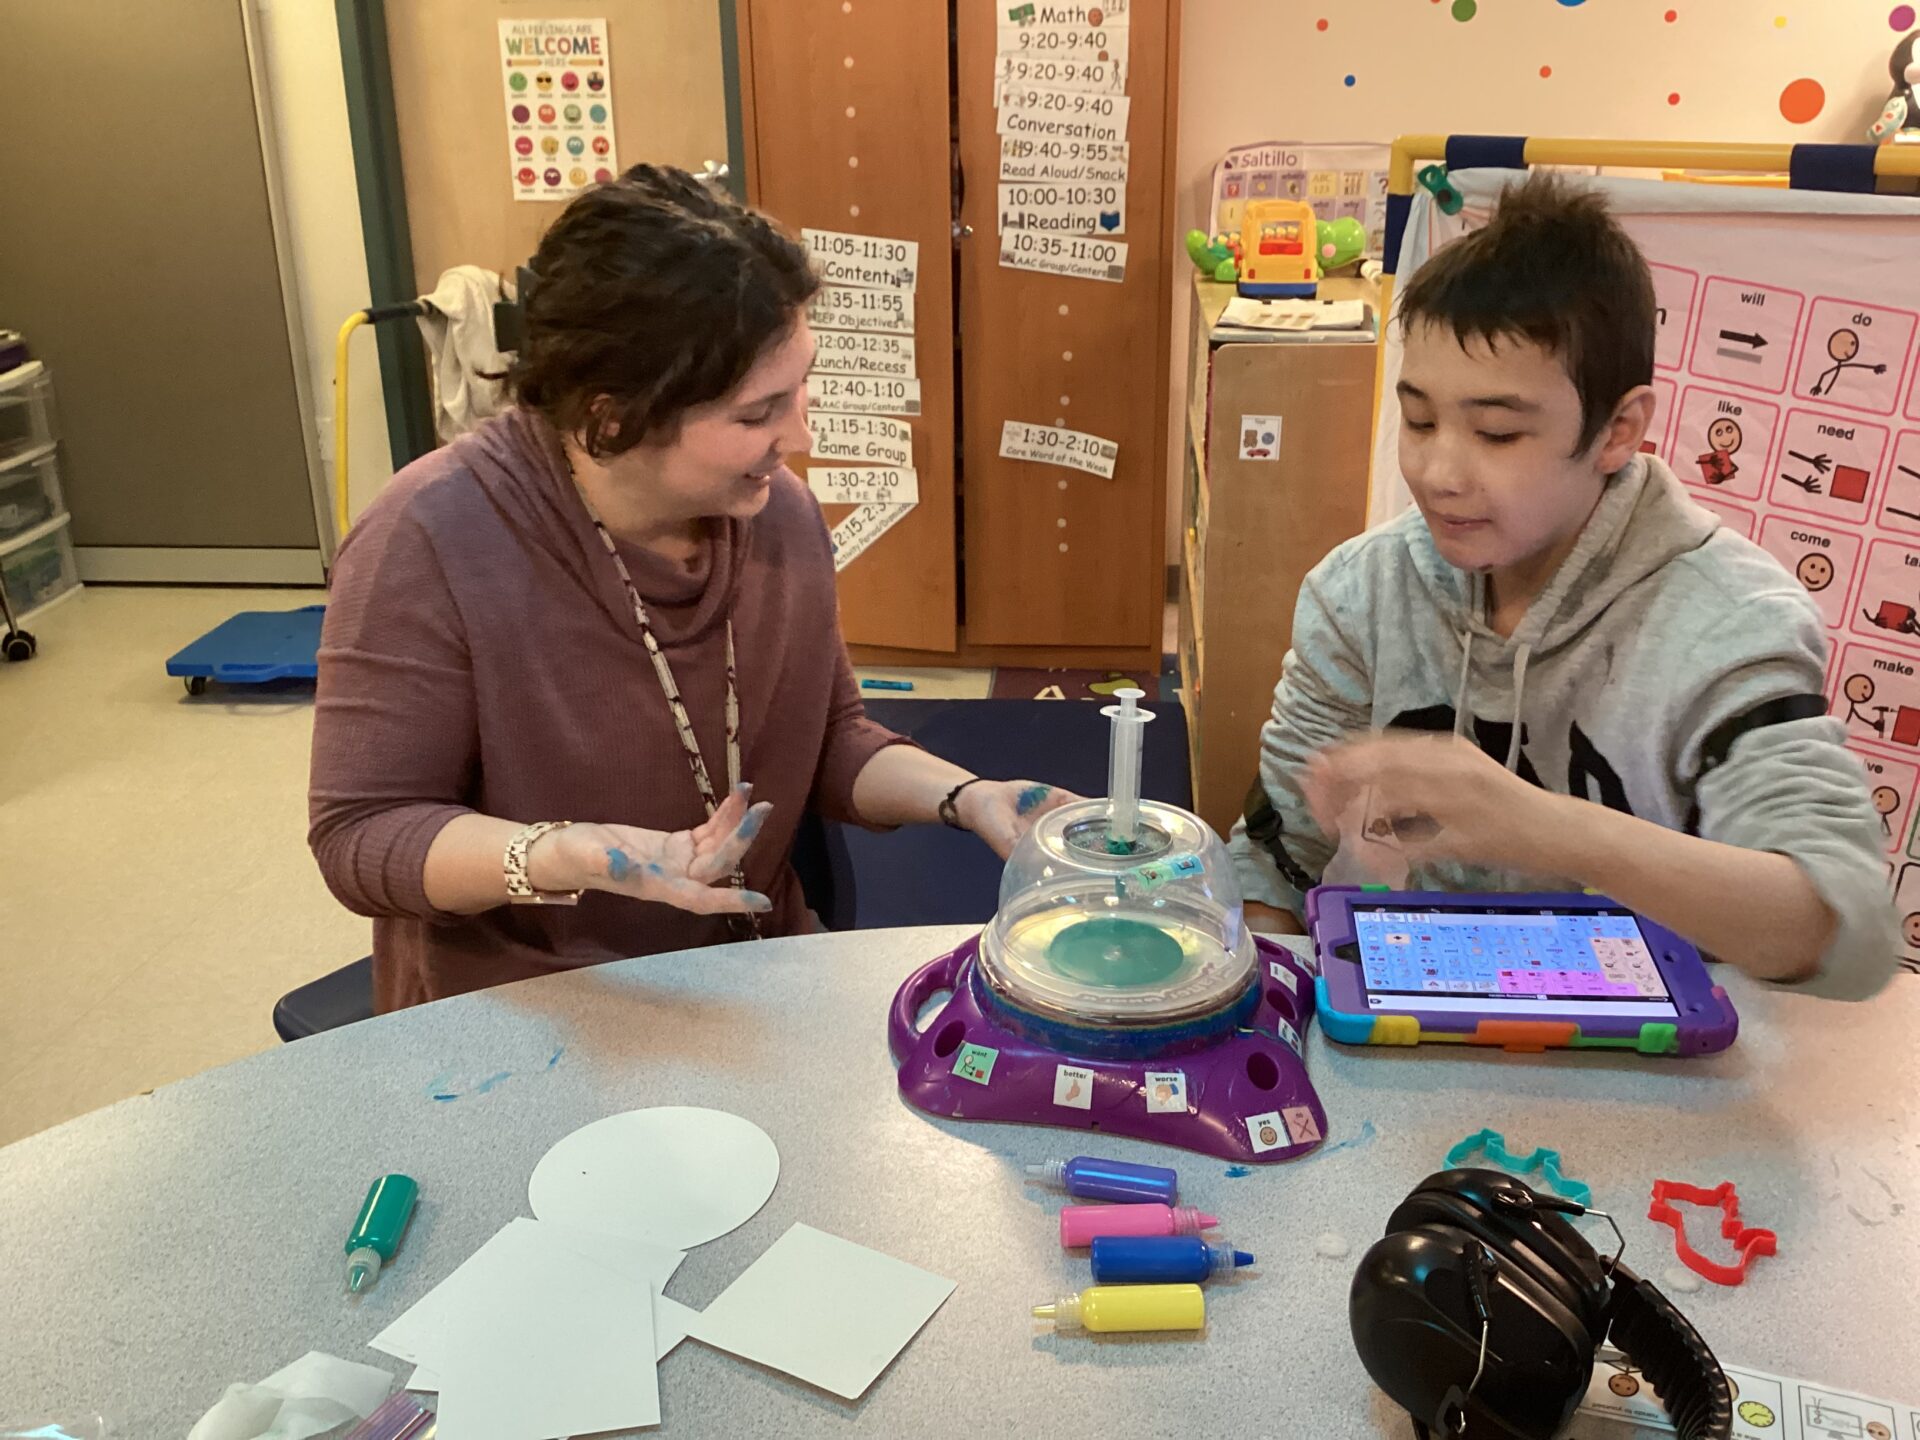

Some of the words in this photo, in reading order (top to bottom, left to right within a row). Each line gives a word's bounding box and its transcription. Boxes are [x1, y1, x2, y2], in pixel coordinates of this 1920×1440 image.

[1040, 6, 1086, 23] Math
[506, 37, 601, 55] WELCOME
[1019, 31, 1107, 49] 9:20-9:40
[1016, 62, 1104, 82] 9:20-9:40
[1027, 91, 1113, 116] 9:20-9:40
[1007, 114, 1116, 141] Conversation
[1022, 141, 1108, 161] 9:40-9:55
[1241, 151, 1297, 168] Saltillo
[1002, 163, 1035, 177] Read
[1040, 165, 1126, 182] Aloud/Snack
[1008, 187, 1117, 206] 10:00-10:30
[1027, 212, 1097, 235] Reading
[813, 235, 906, 262] 11:05-11:30
[1013, 234, 1117, 264] 10:35-11:00
[825, 261, 889, 284] Content
[1740, 292, 1765, 306] will
[838, 314, 899, 330] Objectives
[1852, 313, 1872, 327] do
[818, 334, 900, 354] 12:00-12:35
[822, 380, 905, 398] 12:40-1:10
[842, 400, 906, 412] Group/Centers
[1718, 400, 1743, 416] like
[828, 418, 897, 438] 1:15-1:30
[1817, 424, 1855, 441] need
[1023, 428, 1100, 456] 1:30-2:10
[818, 440, 861, 456] Game
[866, 442, 907, 463] Group
[1006, 446, 1027, 457] Core
[1030, 449, 1054, 461] Word
[1055, 452, 1066, 463] of
[1069, 456, 1083, 467] the
[1086, 460, 1108, 475] Week
[826, 472, 899, 487] 1:30-2:10
[1790, 530, 1831, 548] come
[1904, 553, 1920, 568] ta
[1873, 659, 1914, 676] make
[971, 1049, 988, 1059] want
[1063, 1069, 1088, 1080] better
[1257, 1118, 1271, 1127] yes
